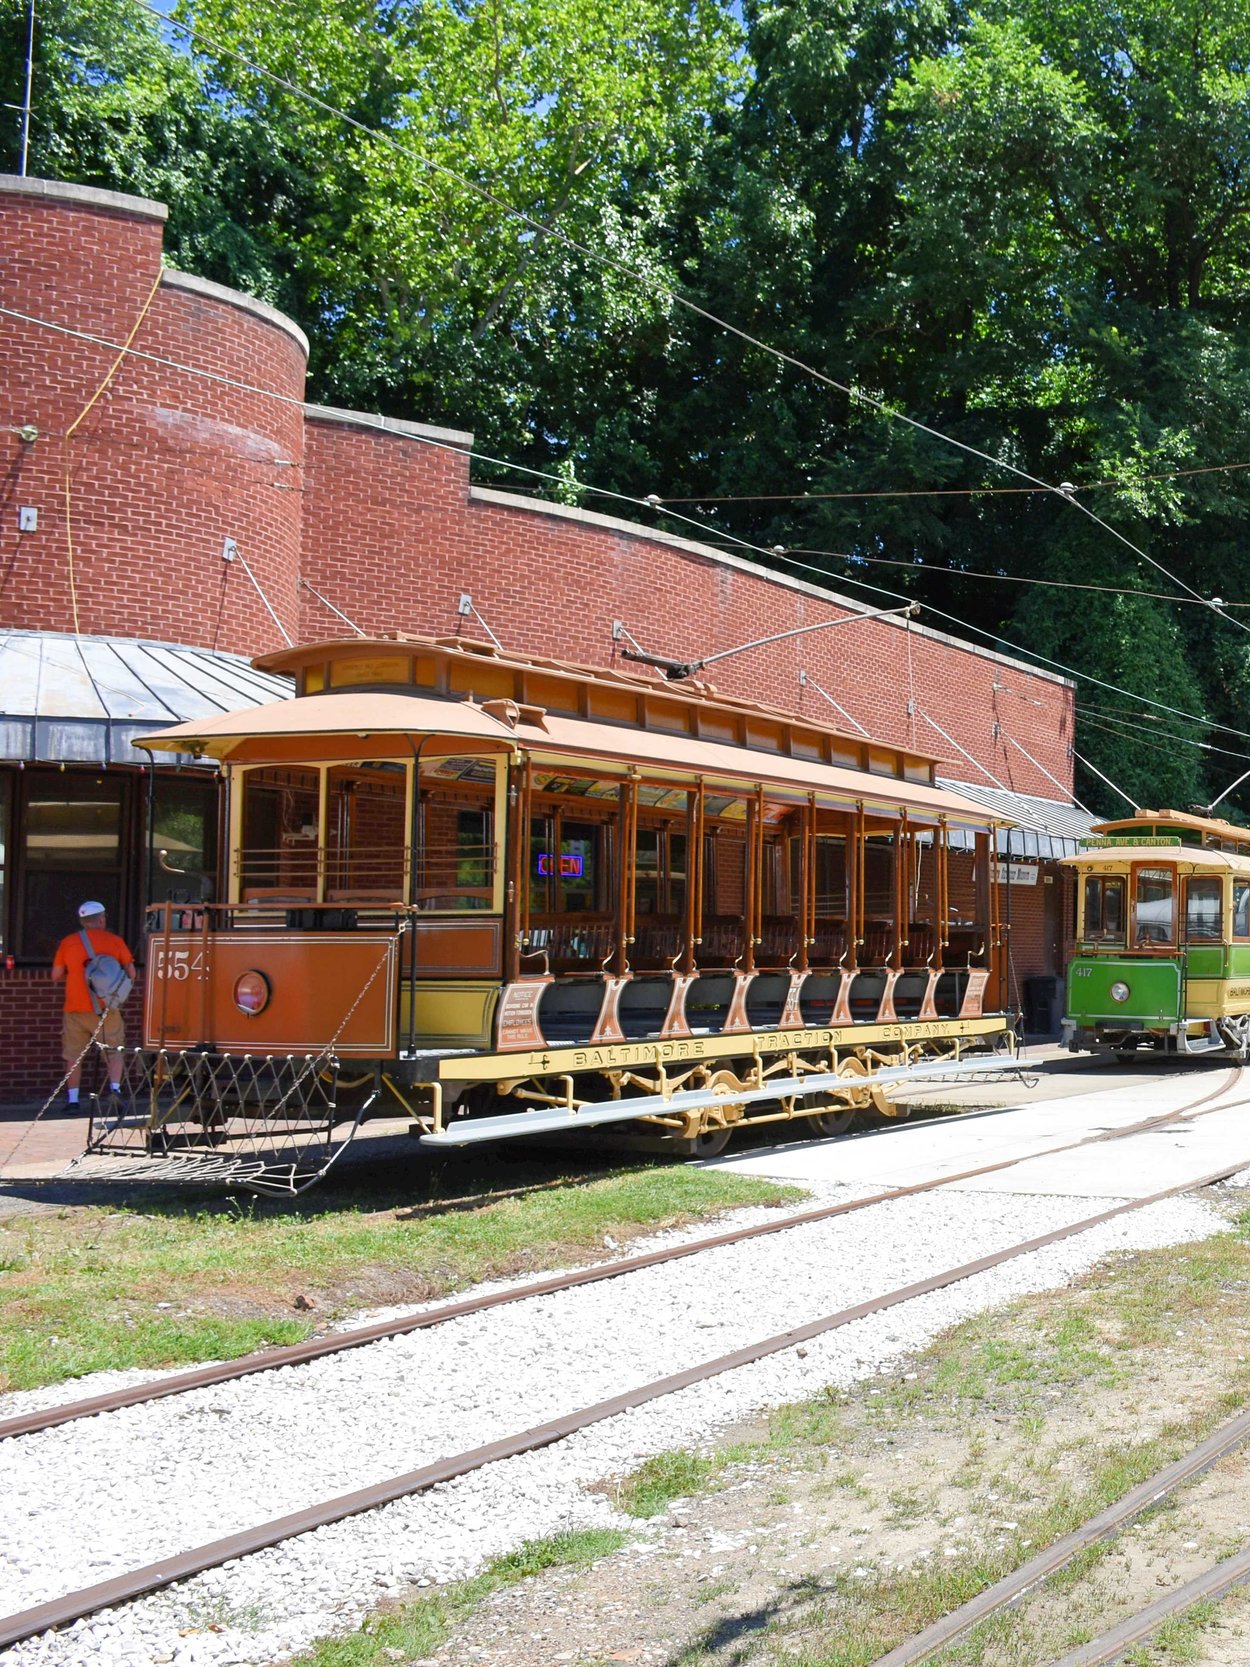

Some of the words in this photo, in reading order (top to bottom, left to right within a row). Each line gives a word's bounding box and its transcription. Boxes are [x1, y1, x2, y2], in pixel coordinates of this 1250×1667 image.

[1132, 838, 1140, 846] &
[1076, 967, 1093, 977] 417
[572, 1041, 705, 1067] BALTIMORE
[757, 1030, 842, 1049] TRACTION
